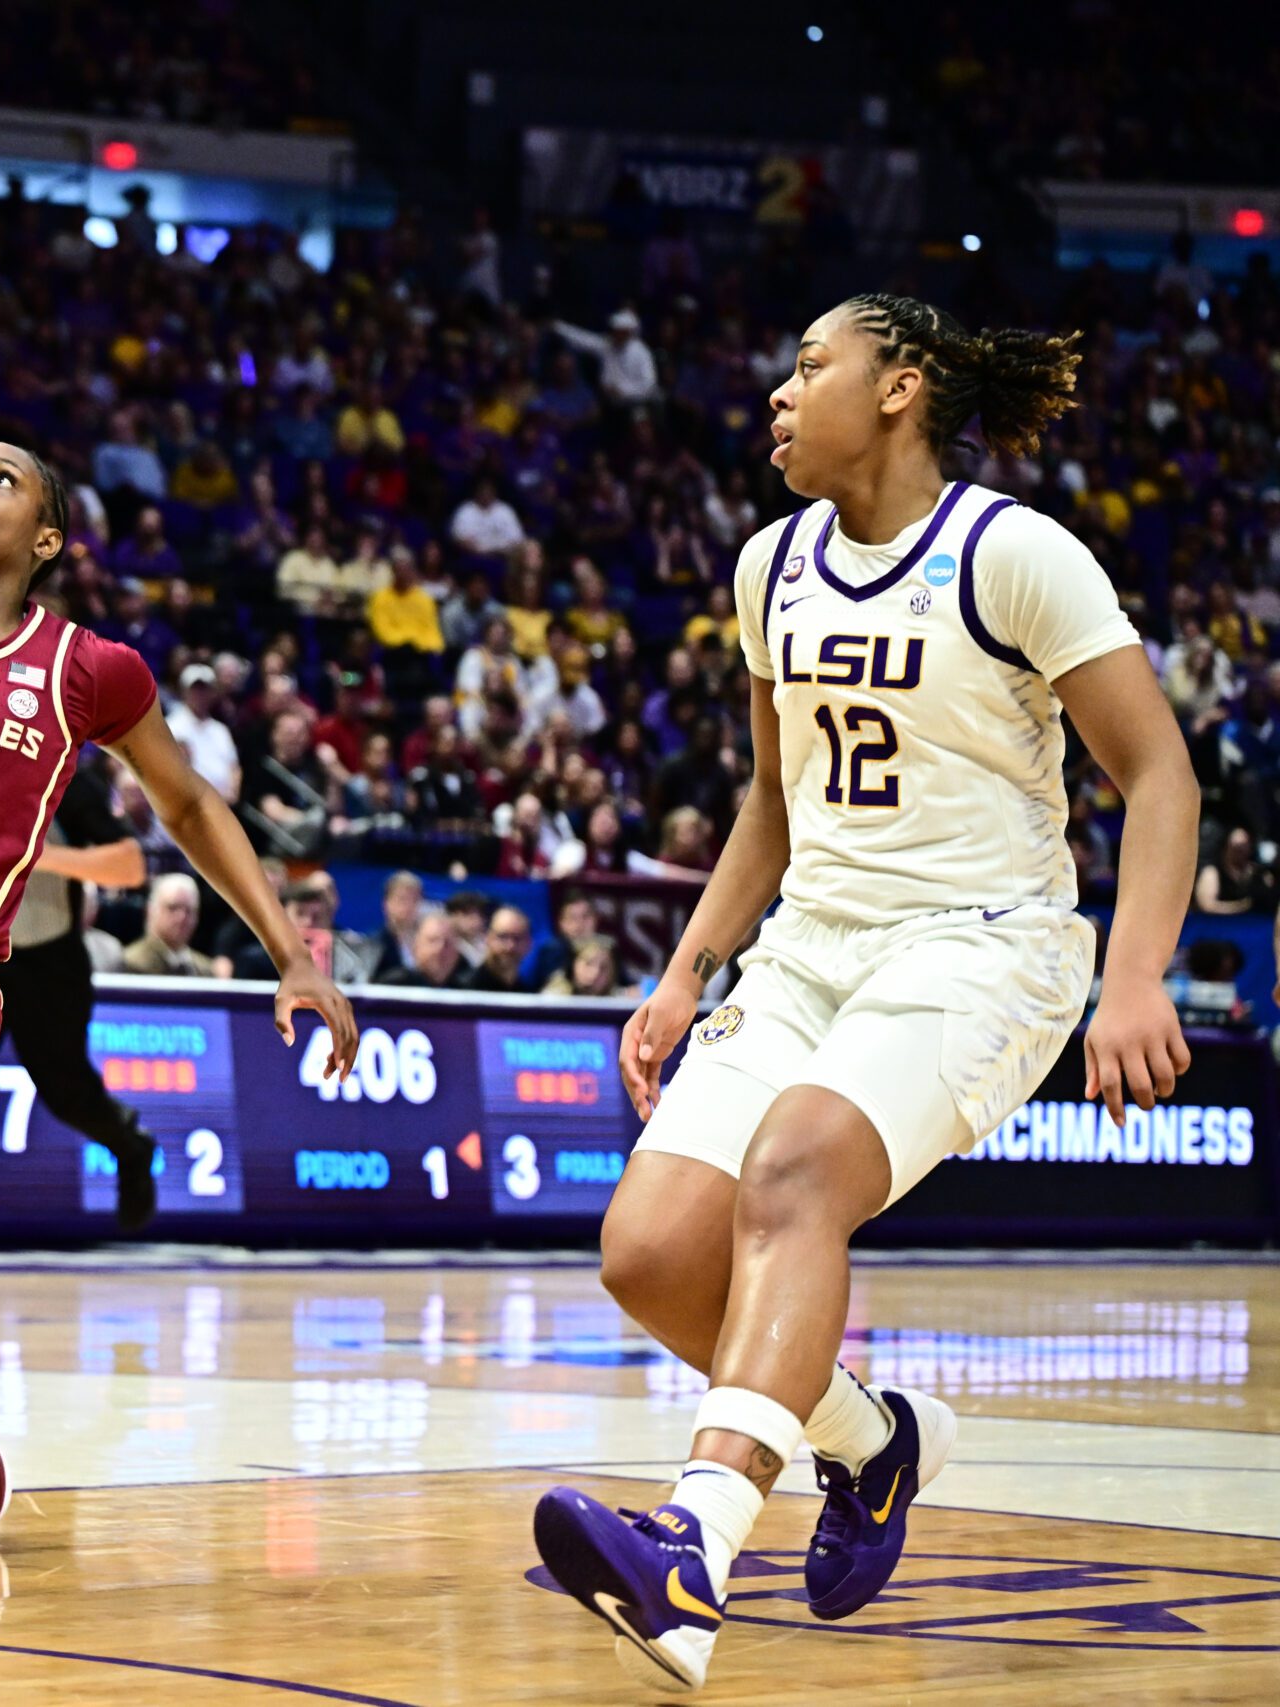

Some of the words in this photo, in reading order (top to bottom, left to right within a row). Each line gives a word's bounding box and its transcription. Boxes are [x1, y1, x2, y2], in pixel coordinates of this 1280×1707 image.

[782, 632, 925, 691] LSU
[814, 704, 900, 808] 12
[87, 1021, 207, 1057] TIMEOUTS
[502, 1036, 607, 1071] TIMEOUTS
[185, 1128, 226, 1196] 2
[294, 1149, 391, 1189] PERIOD
[422, 1146, 449, 1200] 1
[503, 1134, 541, 1200] 3
[555, 1150, 625, 1184] FOULS
